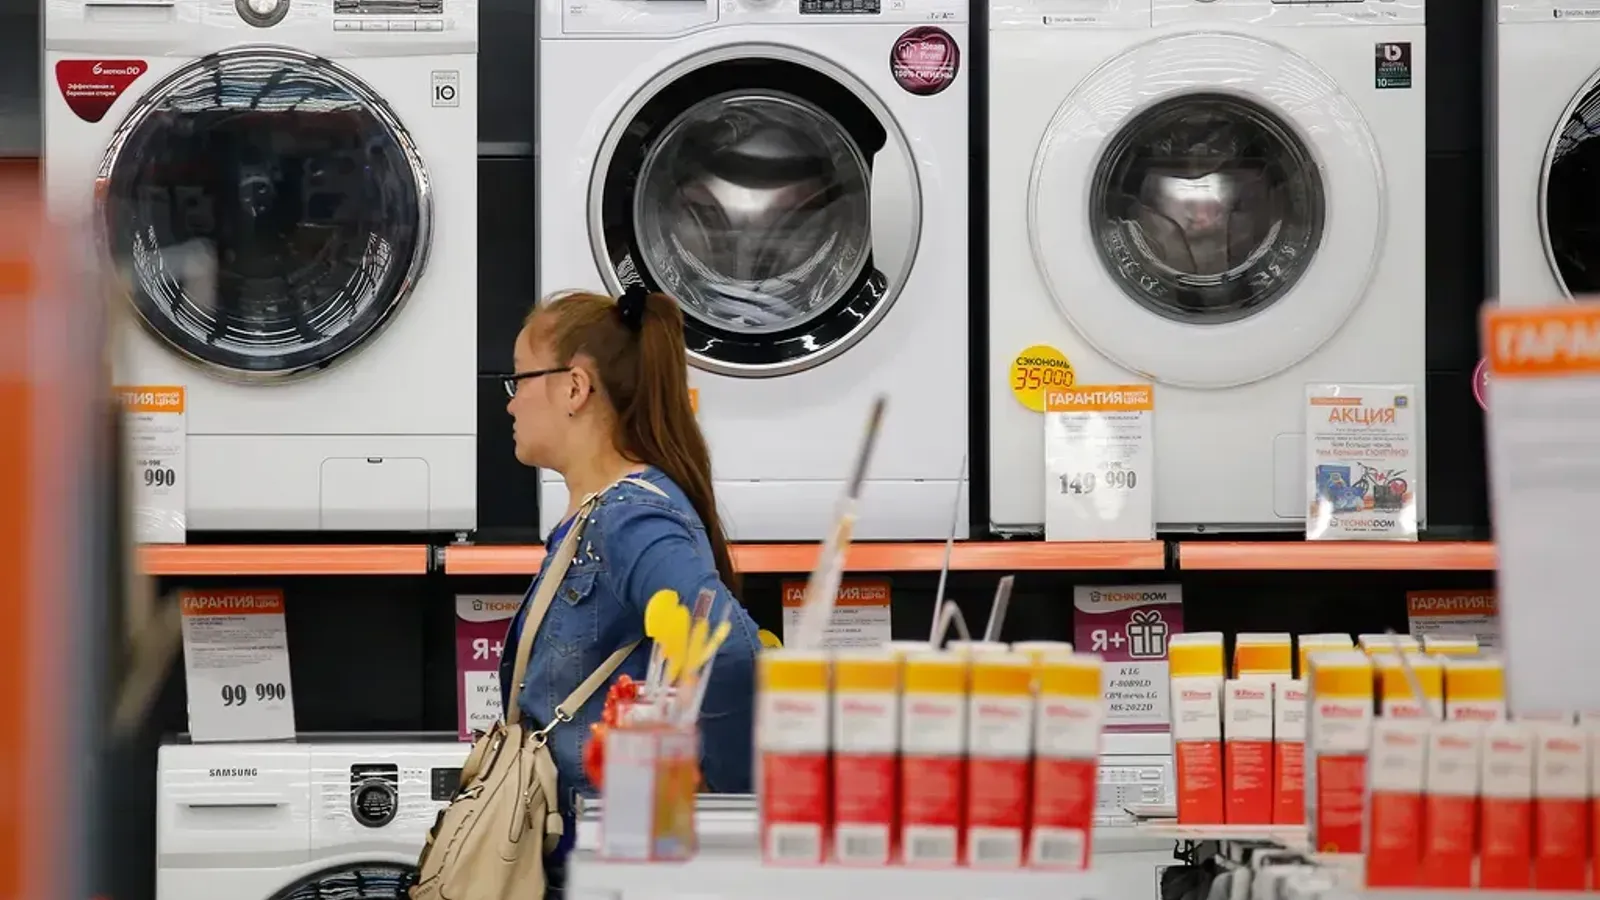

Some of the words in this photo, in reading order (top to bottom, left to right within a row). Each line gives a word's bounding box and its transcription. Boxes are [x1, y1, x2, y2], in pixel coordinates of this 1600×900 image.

[1377, 78, 1388, 88] 10
[1016, 357, 1070, 369] СЭКОНОМЬ
[1049, 390, 1123, 405] ГАРАНТИЯ
[1329, 407, 1395, 425] АКЦИЯ
[144, 469, 176, 487] 990
[1059, 472, 1097, 494] 149
[1105, 470, 1137, 489] 990
[184, 596, 254, 609] ГАРАНТИЯ
[1104, 592, 1168, 601] TECHNODOM
[1411, 596, 1485, 610] ГАРАНТИЯ
[221, 684, 248, 706] 99
[255, 682, 286, 701] 990
[209, 768, 258, 777] SAMSUNG
